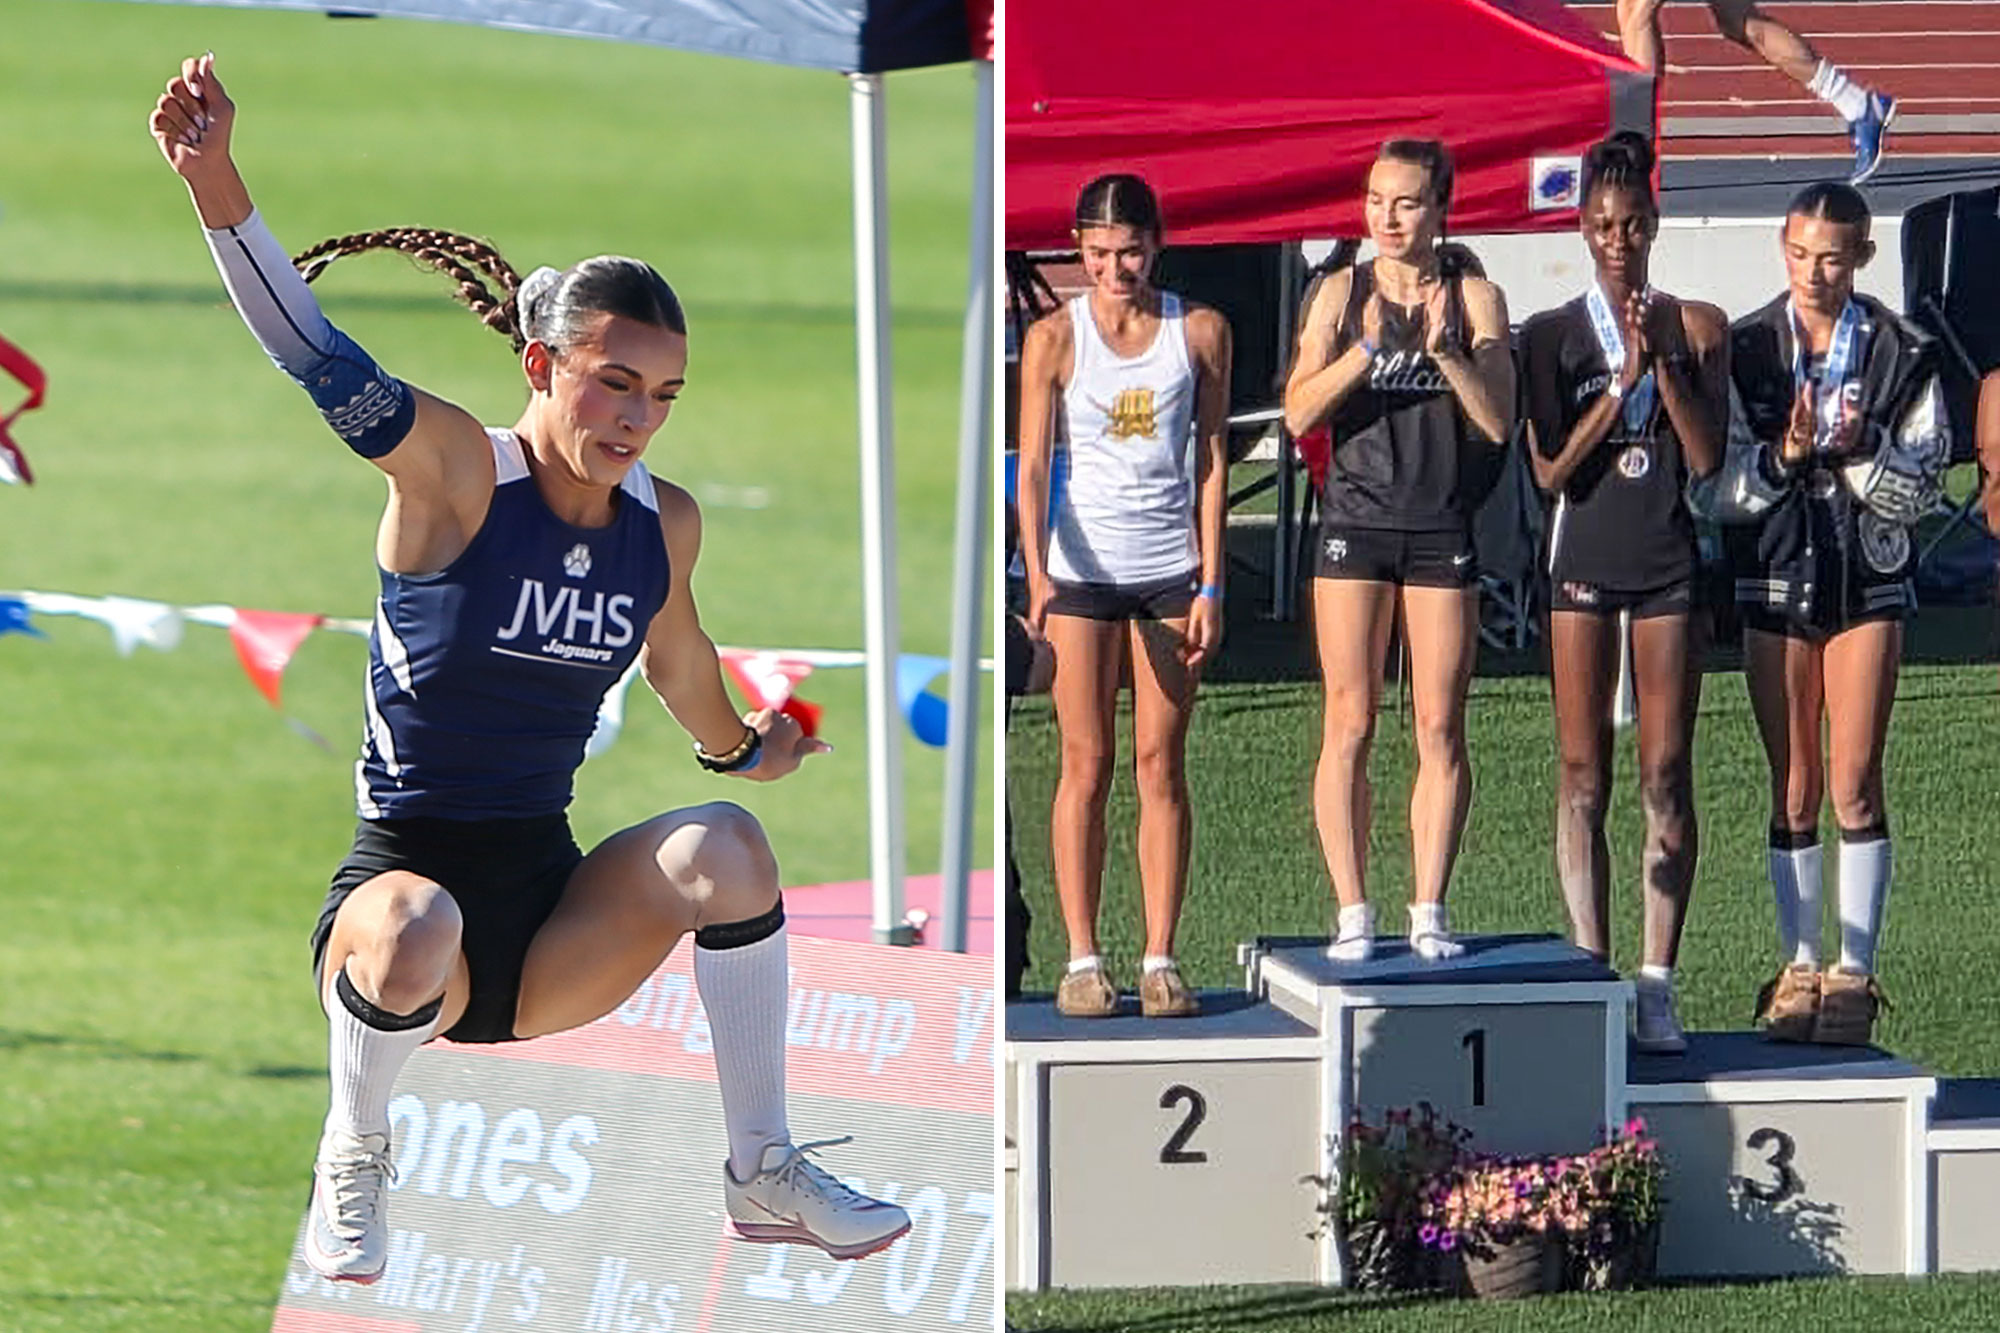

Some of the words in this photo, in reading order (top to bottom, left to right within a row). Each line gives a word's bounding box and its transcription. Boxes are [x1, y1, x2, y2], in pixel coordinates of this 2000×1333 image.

[497, 578, 634, 648] JVHS
[542, 638, 613, 662] Jaguars
[787, 967, 917, 1077] ump
[1462, 1029, 1486, 1107] 1
[387, 1094, 600, 1214] ones
[1159, 1084, 1207, 1164] 2
[1746, 1127, 1804, 1202] 3
[375, 1230, 546, 1333] Mary's
